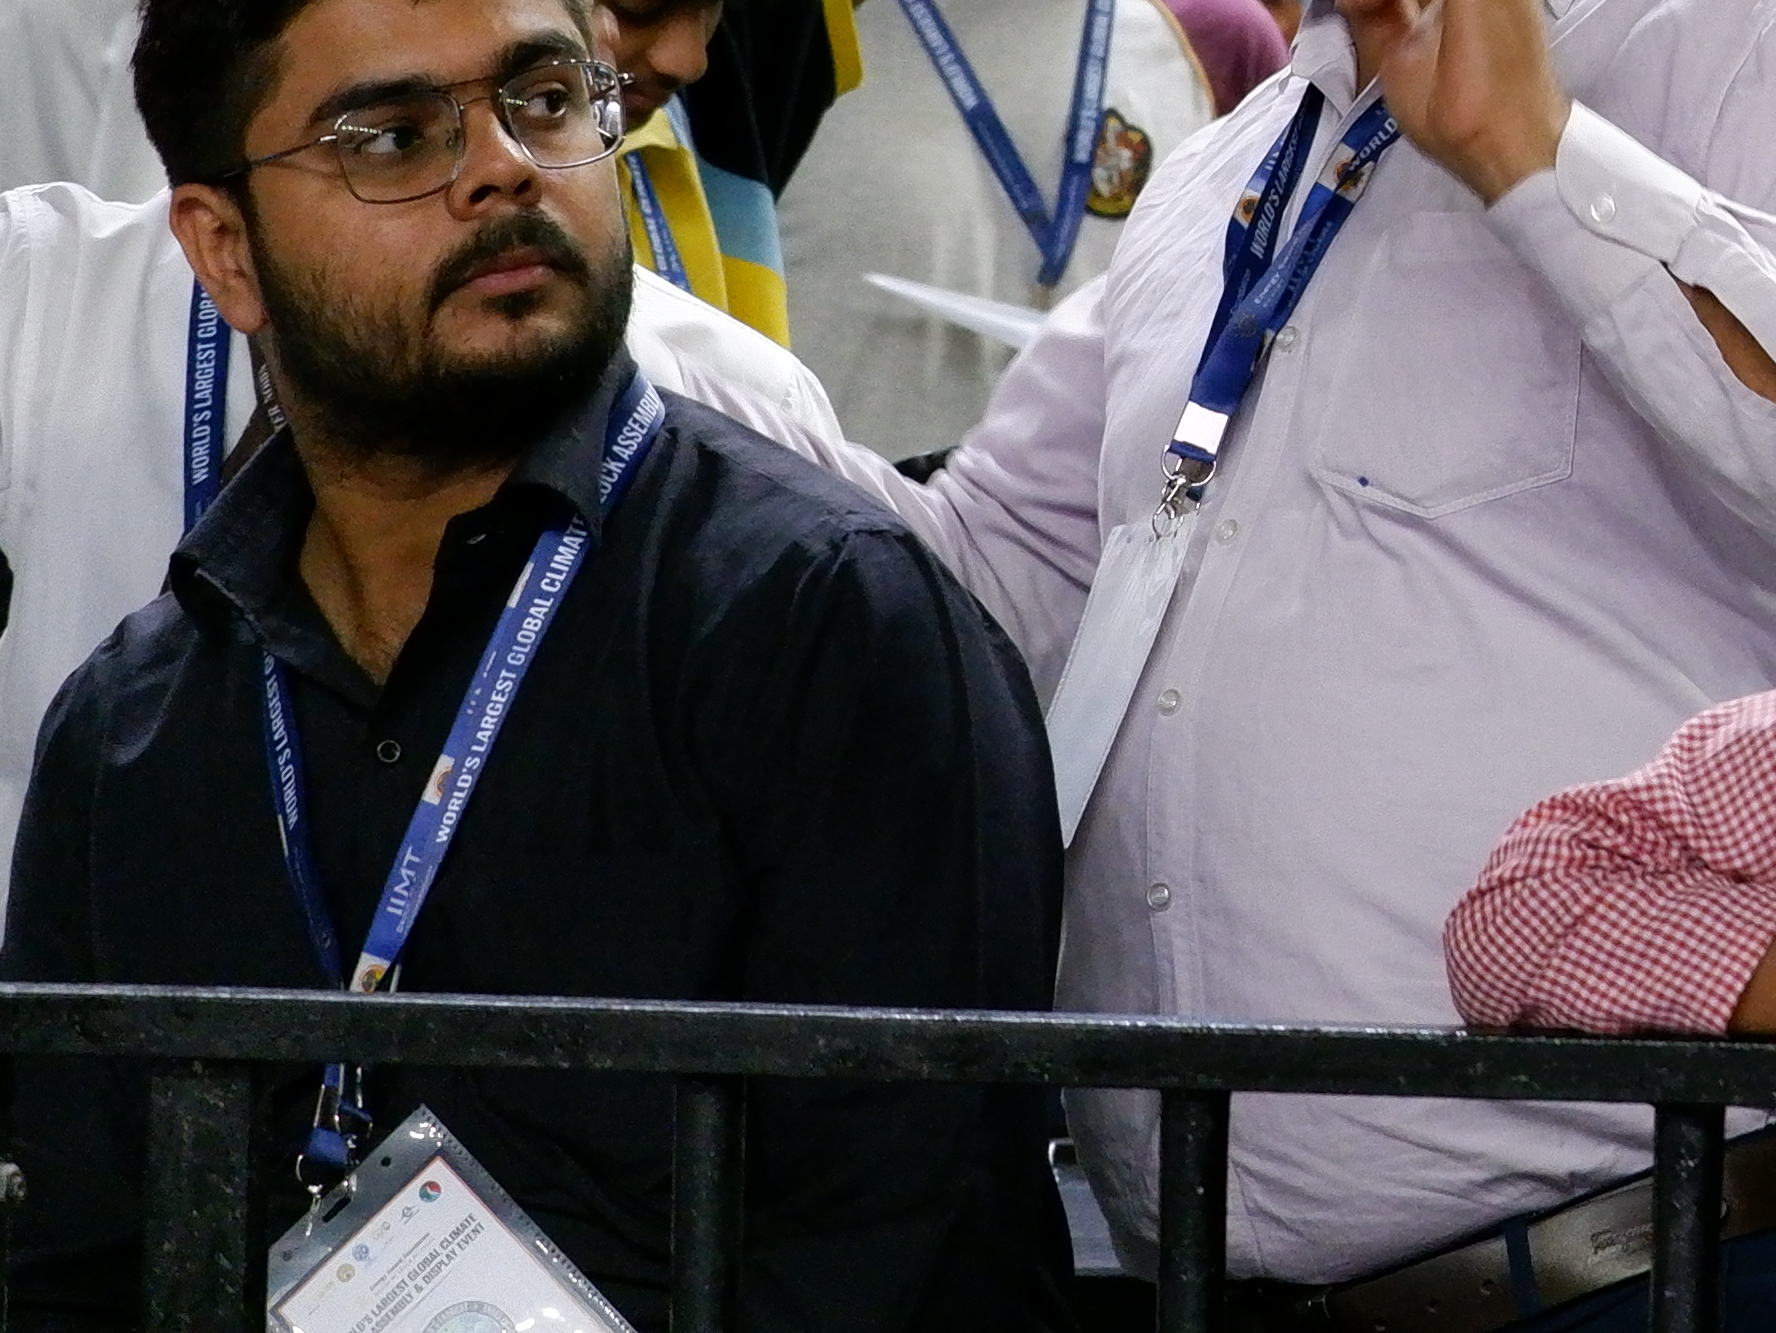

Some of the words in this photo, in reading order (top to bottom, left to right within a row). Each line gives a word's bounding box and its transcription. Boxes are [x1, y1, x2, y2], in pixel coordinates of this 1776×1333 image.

[1250, 189, 1282, 259] WORLD'S
[194, 343, 217, 410] LARGEST
[192, 411, 212, 486] WORLD'S
[589, 455, 628, 507] LOCK
[266, 675, 289, 747] LARGEST
[432, 753, 484, 843] WORLD'S
[470, 669, 519, 754] LARGEST
[506, 591, 555, 667] GLOBAL
[278, 747, 299, 830] WORLD'S
